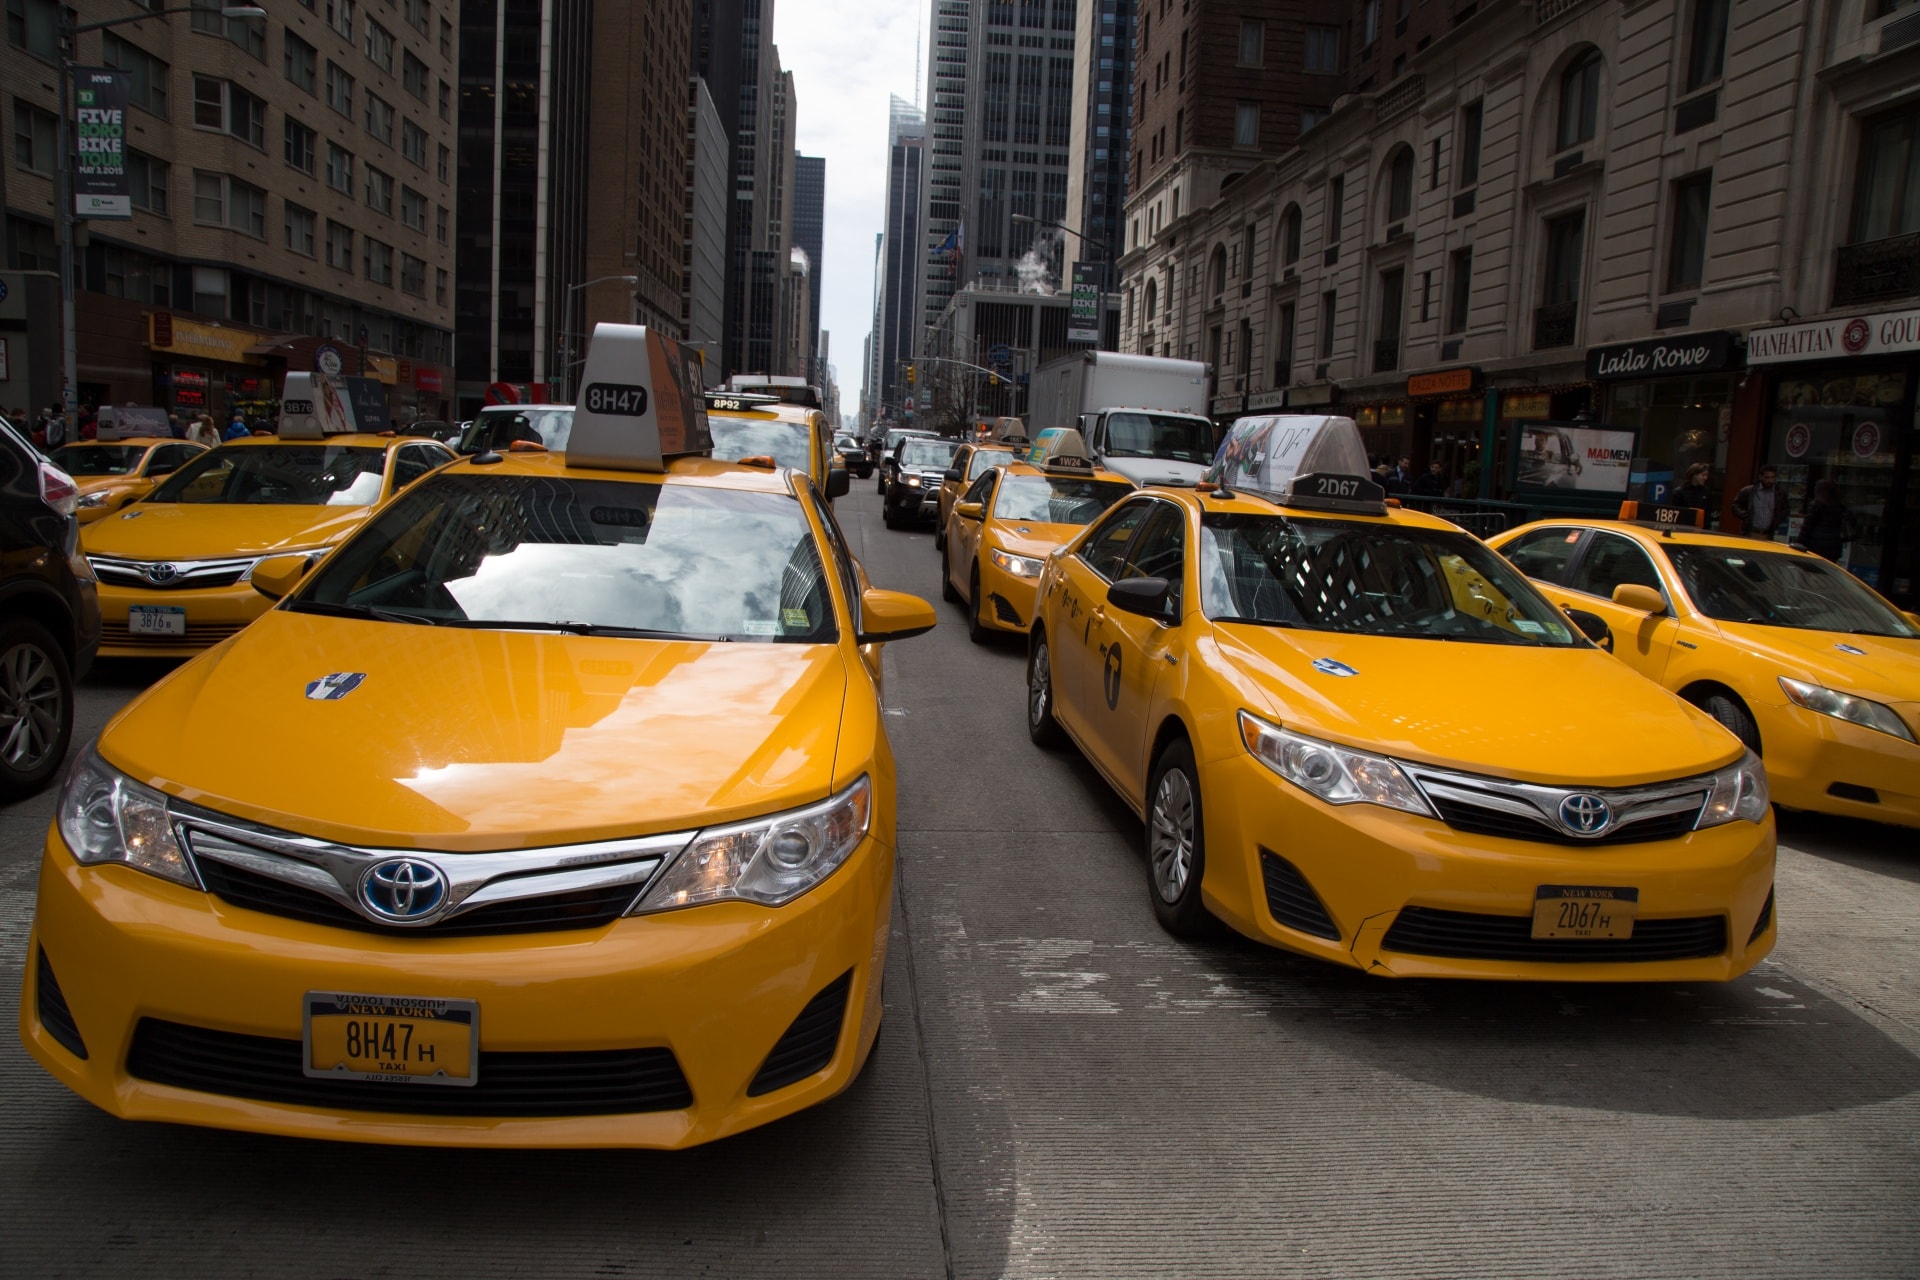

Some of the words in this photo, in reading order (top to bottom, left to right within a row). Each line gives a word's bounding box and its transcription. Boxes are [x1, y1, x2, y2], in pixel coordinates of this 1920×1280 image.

[91, 75, 113, 84] NYC
[77, 109, 122, 124] FIVE
[78, 124, 123, 137] BORO
[77, 138, 122, 153] BIKE
[79, 153, 122, 167] TOUR
[78, 166, 95, 174] MAY
[1073, 284, 1098, 293] FIVE
[1072, 299, 1097, 308] BIKE
[1749, 327, 1835, 358] MANHATTAN
[1881, 316, 1920, 345] GOU
[1598, 347, 1650, 375] Laila
[1652, 345, 1711, 372] Rowe
[1411, 377, 1436, 391] PAZZA
[1438, 373, 1468, 388] NOTTE
[589, 387, 643, 412] 8H47
[713, 399, 740, 410] 8P92
[286, 402, 313, 413] 3B76
[1060, 457, 1081, 467] 1W24
[1318, 478, 1359, 496] 2D67
[1655, 484, 1665, 501] P
[1655, 508, 1680, 523] 1B87
[141, 613, 164, 628] 3B76
[1562, 889, 1589, 898] NEW
[1590, 889, 1615, 898] YORK
[1557, 902, 1601, 929] 2D67
[1599, 916, 1611, 929] H
[336, 994, 385, 1006] TOYOTA
[390, 998, 446, 1008] HUDSON
[348, 1004, 387, 1015] NEW
[393, 1005, 435, 1018] YORK
[346, 1020, 414, 1061] 8H47
[418, 1044, 435, 1062] H
[379, 1062, 406, 1071] TAXI
